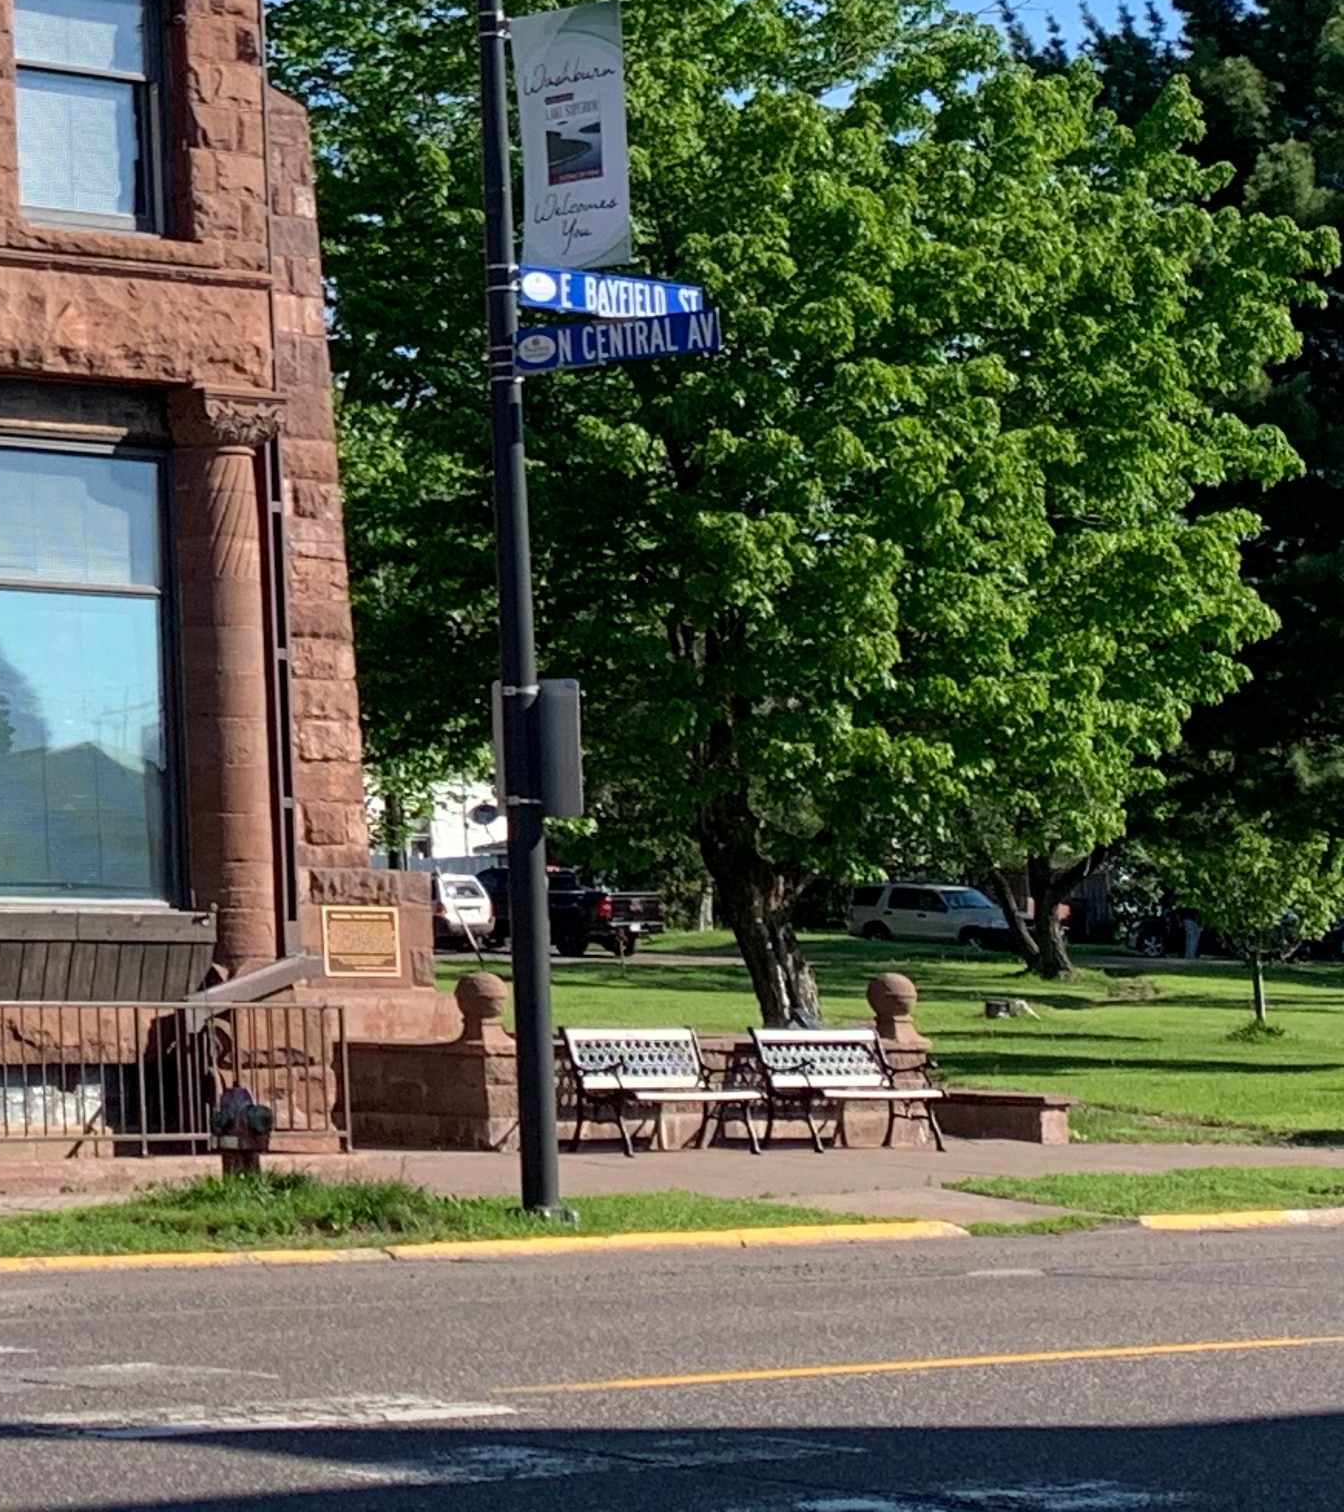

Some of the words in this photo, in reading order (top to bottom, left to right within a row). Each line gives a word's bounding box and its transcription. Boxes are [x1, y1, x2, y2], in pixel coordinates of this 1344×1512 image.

[524, 57, 616, 96] Washburn
[533, 192, 619, 224] Welcomes
[561, 218, 592, 256] You
[561, 273, 573, 309] E
[584, 276, 667, 318] BAYFIELD
[678, 288, 699, 313] ST
[558, 328, 573, 364] N
[582, 317, 679, 359] CENTRAL
